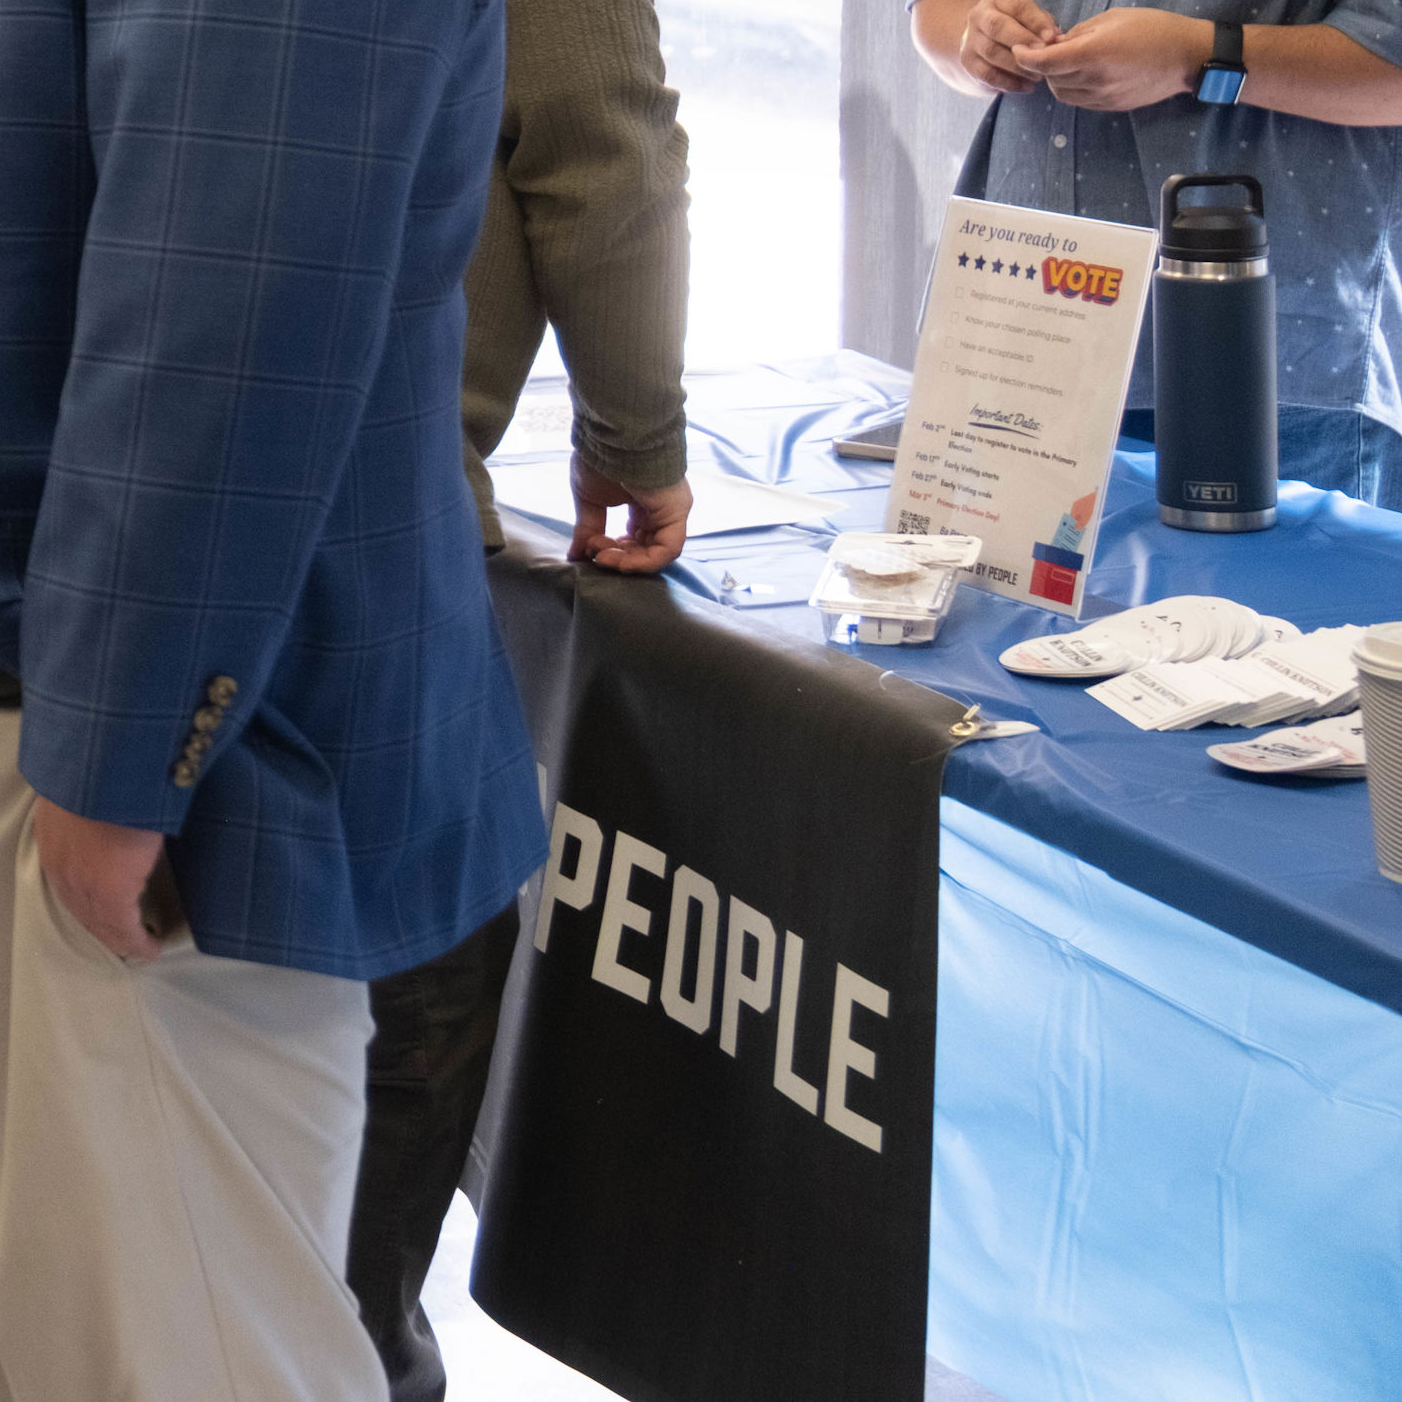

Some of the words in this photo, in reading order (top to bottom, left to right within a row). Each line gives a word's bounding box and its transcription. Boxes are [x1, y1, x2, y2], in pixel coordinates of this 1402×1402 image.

[959, 219, 986, 236] Are
[986, 227, 1014, 242] you
[1018, 232, 1059, 253] ready
[1062, 238, 1078, 253] to
[1044, 258, 1122, 303] VOTE
[970, 289, 1007, 304] Registered
[1016, 300, 1031, 309] your
[1031, 303, 1057, 314] current
[1059, 308, 1086, 320] address
[965, 315, 984, 325] Know
[984, 319, 1000, 330] your
[1001, 322, 1026, 334] chosen
[1027, 327, 1050, 341] polling
[1051, 332, 1071, 344] place
[960, 341, 976, 351] Have
[987, 347, 1024, 361] acceptable
[1025, 354, 1034, 363] ID
[955, 365, 978, 378] Signed
[978, 371, 988, 380] up
[989, 373, 999, 382] for
[999, 375, 1026, 388] election
[1027, 381, 1063, 396] reminders
[969, 403, 1014, 425] Important
[922, 421, 934, 431] Feb
[950, 429, 964, 438] Last
[965, 432, 977, 442] day
[977, 435, 983, 443] to
[984, 437, 1010, 449] register
[1010, 443, 1017, 451] to
[1017, 445, 1032, 455] vote
[1033, 449, 1039, 457] in
[1040, 450, 1050, 460] the
[1052, 453, 1077, 467] Primary
[948, 440, 973, 454] Election
[915, 451, 928, 461] Feb
[944, 460, 960, 472] Early
[960, 463, 981, 478] Voting
[981, 470, 1000, 481] starts
[911, 470, 924, 481] Feb
[940, 479, 956, 491] Early
[957, 483, 977, 496] Voting
[1188, 485, 1232, 500] YETI
[908, 489, 923, 499] Mar
[936, 497, 960, 512] Primary
[961, 504, 985, 518] Election
[976, 562, 987, 576] BY
[988, 566, 1018, 585] PEOPLE
[533, 801, 889, 1153] PEOPLE
